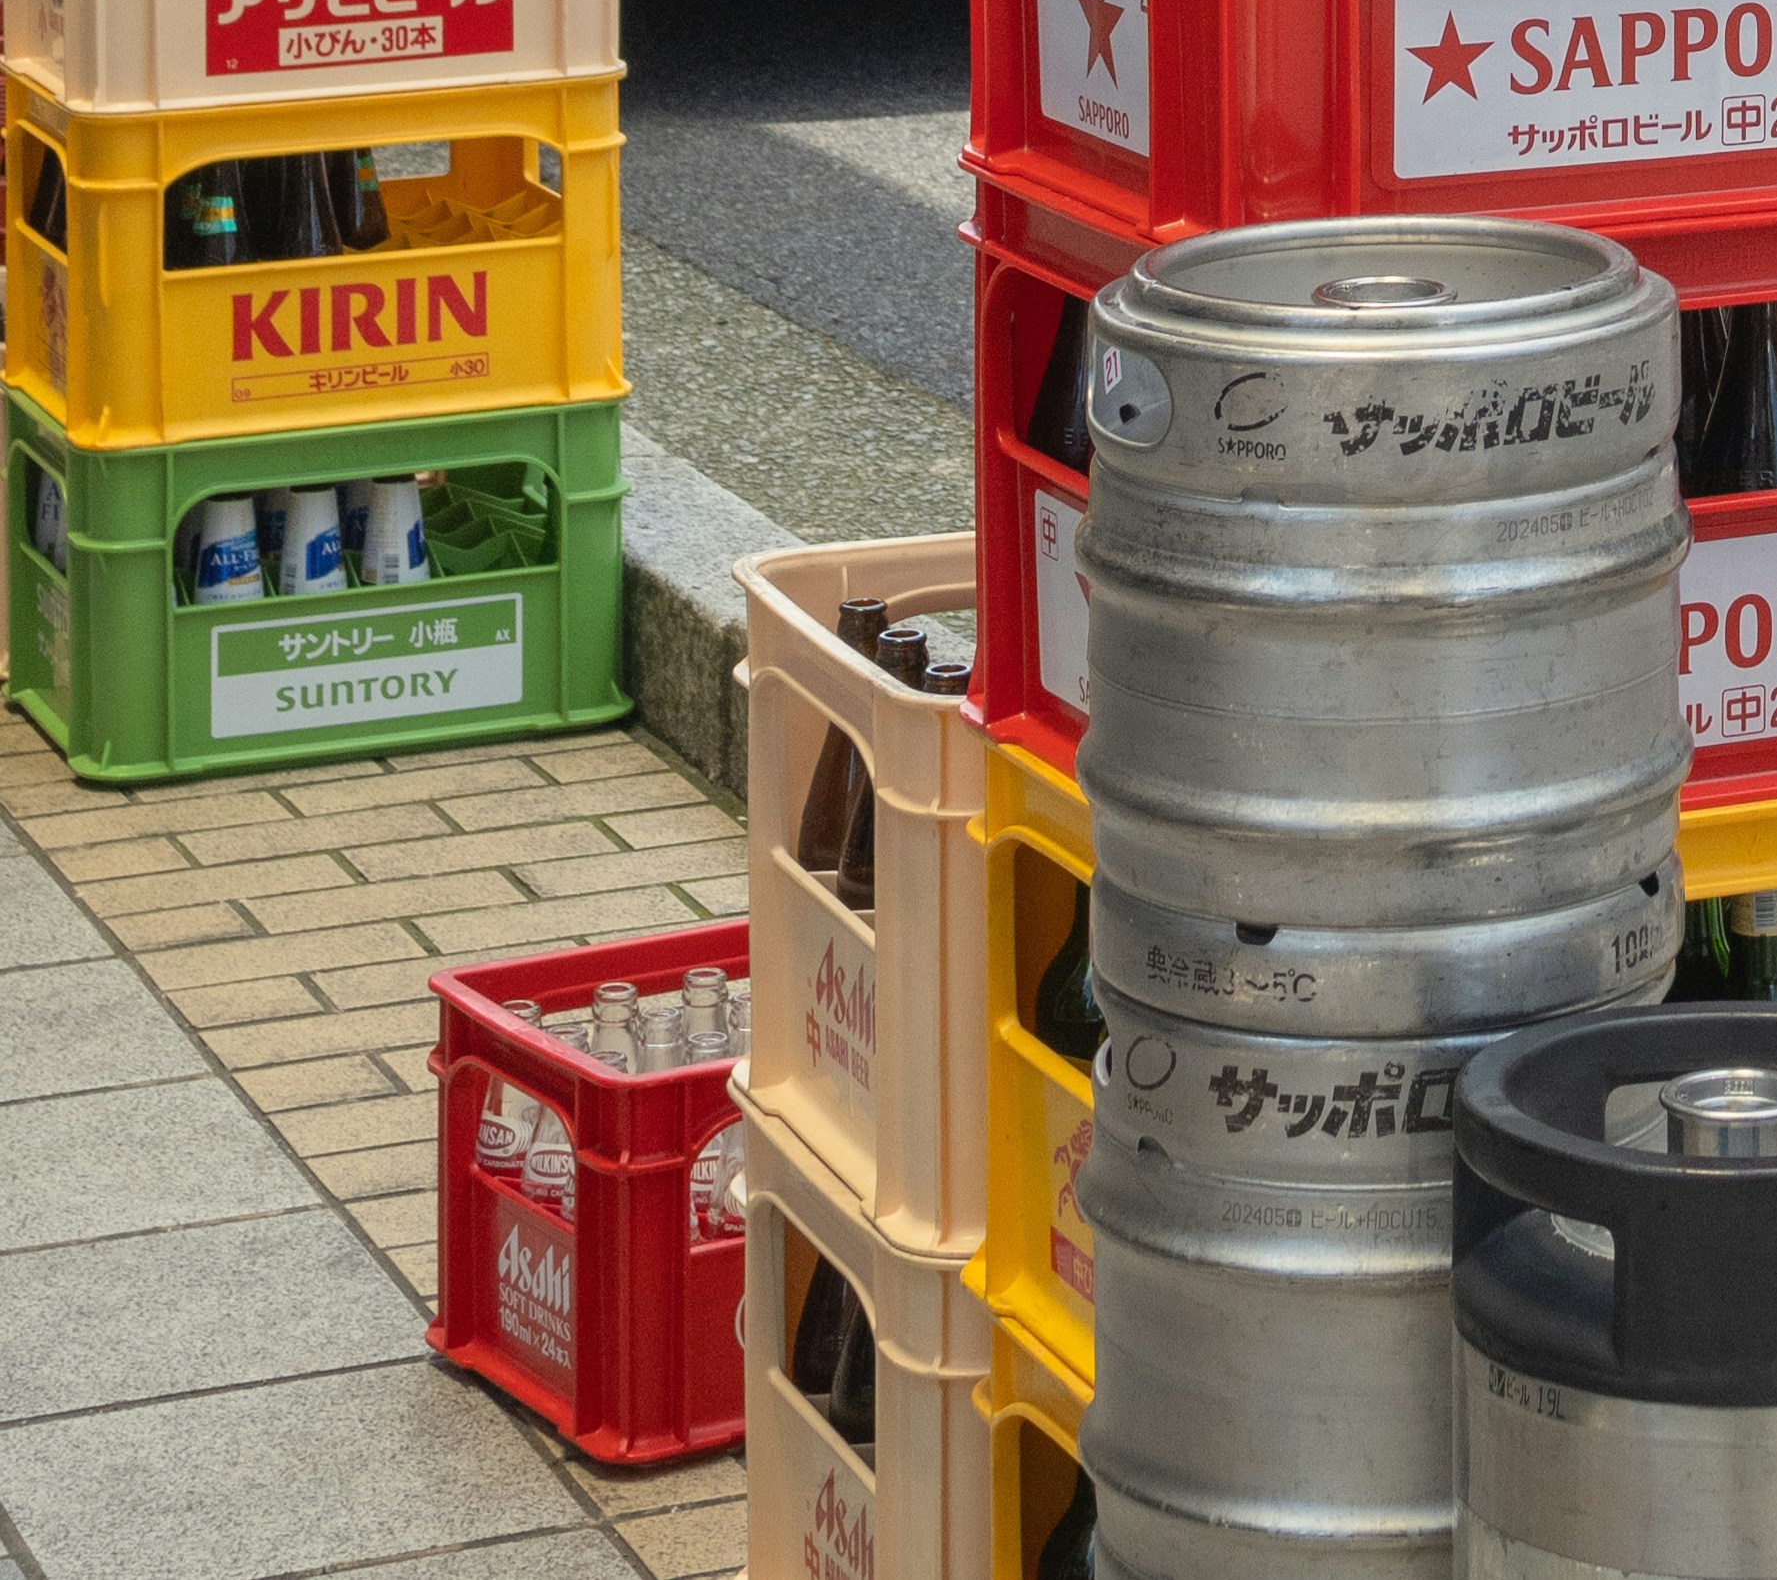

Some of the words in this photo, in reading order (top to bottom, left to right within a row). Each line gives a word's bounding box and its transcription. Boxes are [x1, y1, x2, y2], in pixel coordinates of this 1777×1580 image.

[285, 22, 437, 60] 小びん・30本
[1078, 94, 1130, 140] SAPPORO
[1507, 109, 1713, 157] サッポロビール
[231, 270, 488, 362] KIRIN
[308, 364, 410, 393] キリンビール
[1103, 348, 1121, 389] 21
[278, 626, 395, 662] サントリー
[408, 617, 458, 649] 小瓶
[815, 936, 877, 1056] Asahi
[498, 1224, 570, 1316] Asahi
[499, 1281, 527, 1316] SOFT
[528, 1298, 572, 1343] DRINKS
